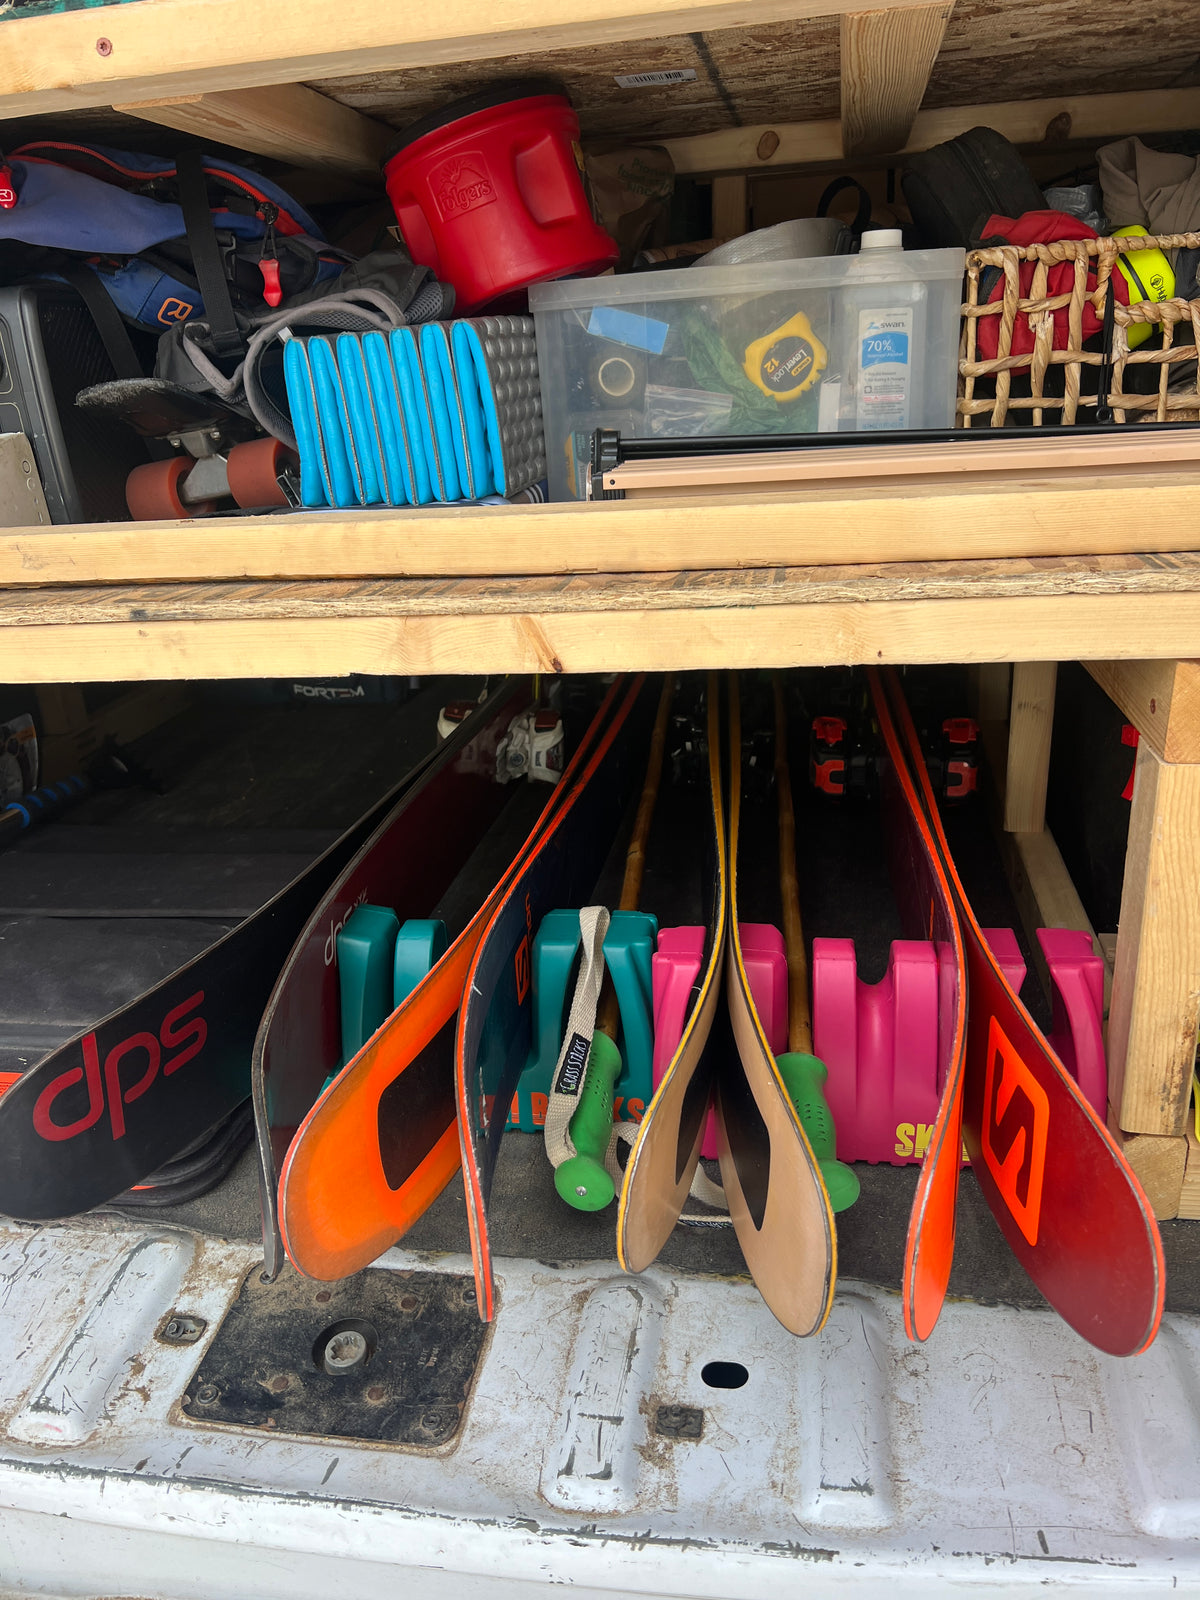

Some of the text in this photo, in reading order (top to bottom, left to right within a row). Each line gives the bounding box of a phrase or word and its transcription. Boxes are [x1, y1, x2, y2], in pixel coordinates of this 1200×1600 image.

[438, 181, 492, 212] Folgers
[880, 321, 905, 329] swan
[867, 339, 892, 352] 70%
[764, 358, 779, 373] 12
[770, 349, 807, 383] LeverLock
[293, 683, 365, 700] FORTEM
[33, 990, 208, 1142] dps
